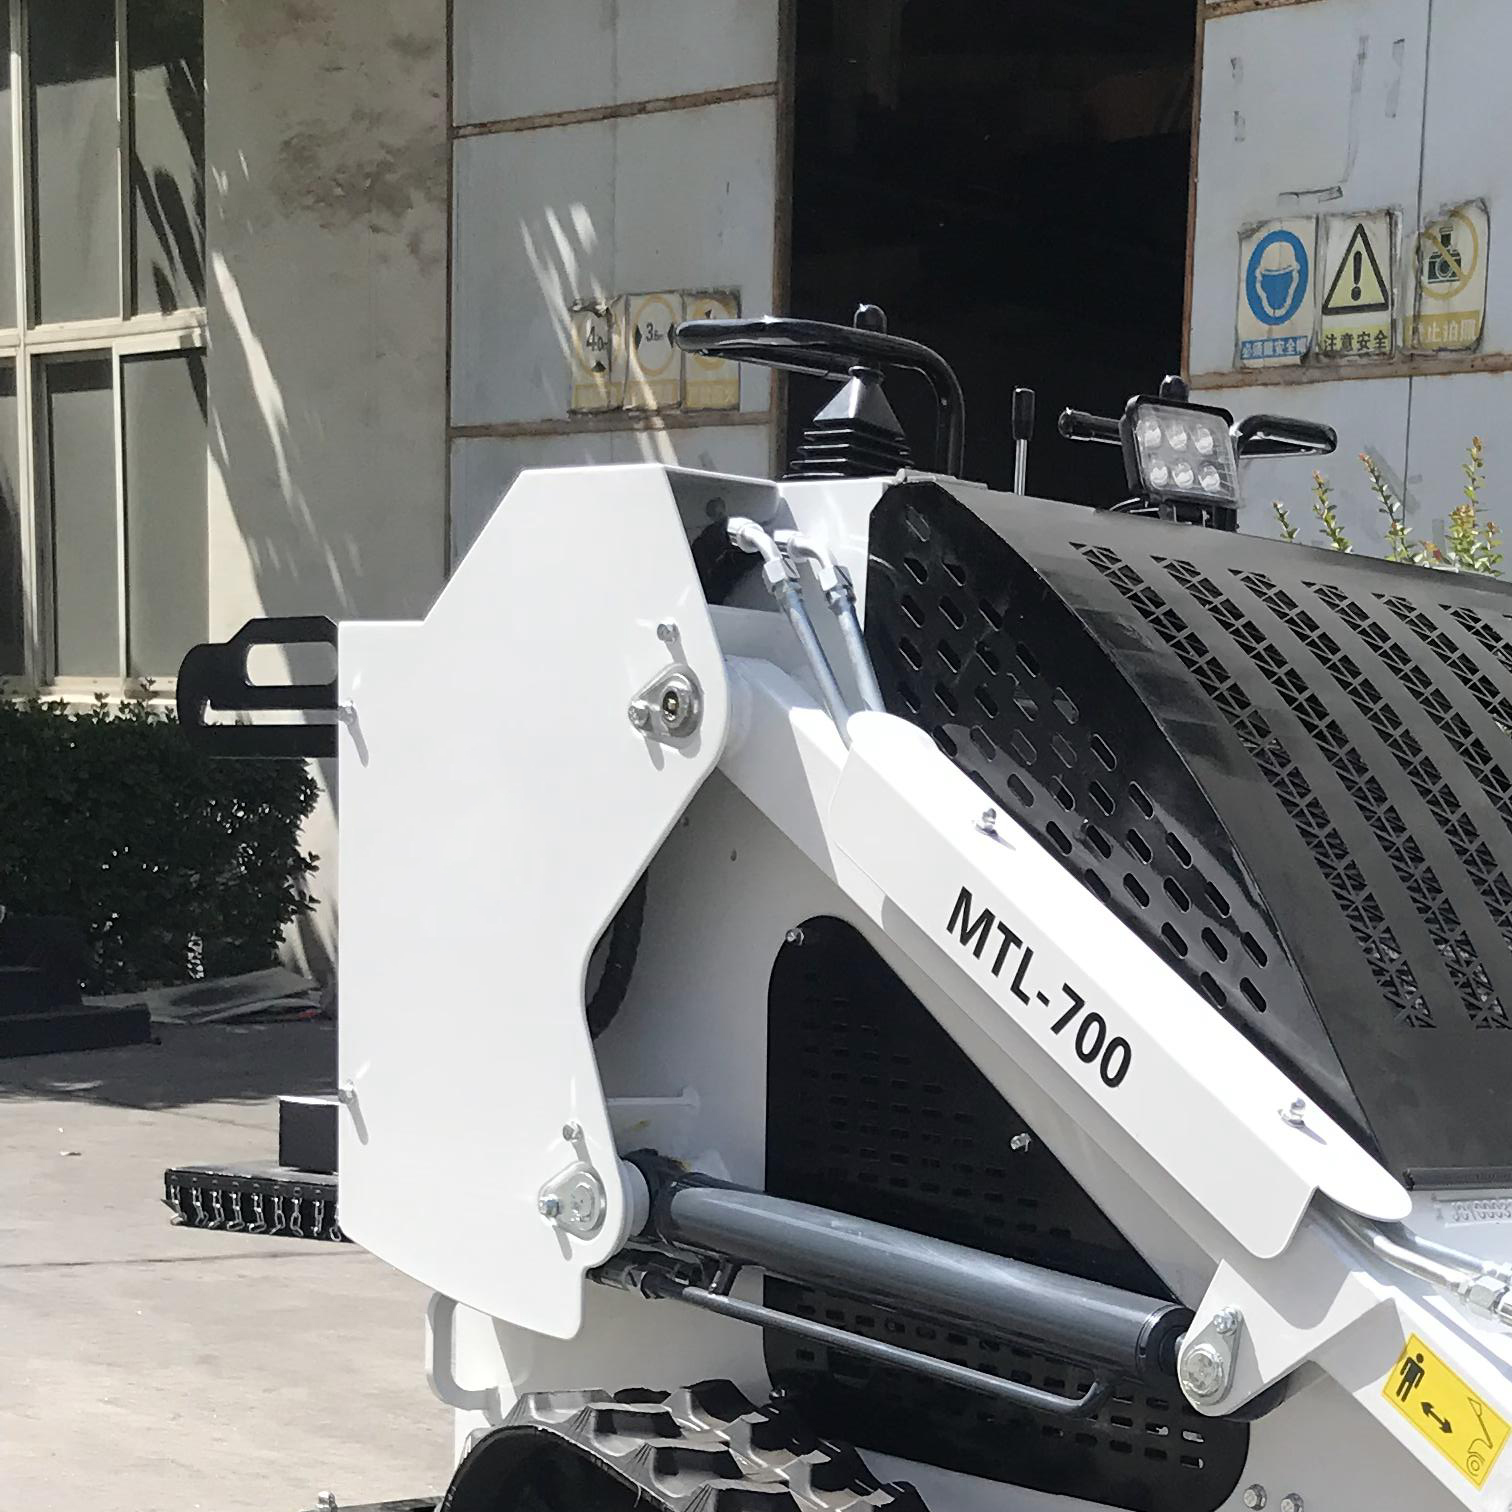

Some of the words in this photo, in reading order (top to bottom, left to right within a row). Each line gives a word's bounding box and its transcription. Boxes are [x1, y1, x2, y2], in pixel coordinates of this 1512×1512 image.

[1324, 330, 1389, 352] 注意安全
[946, 886, 1132, 1089] MTL-700
